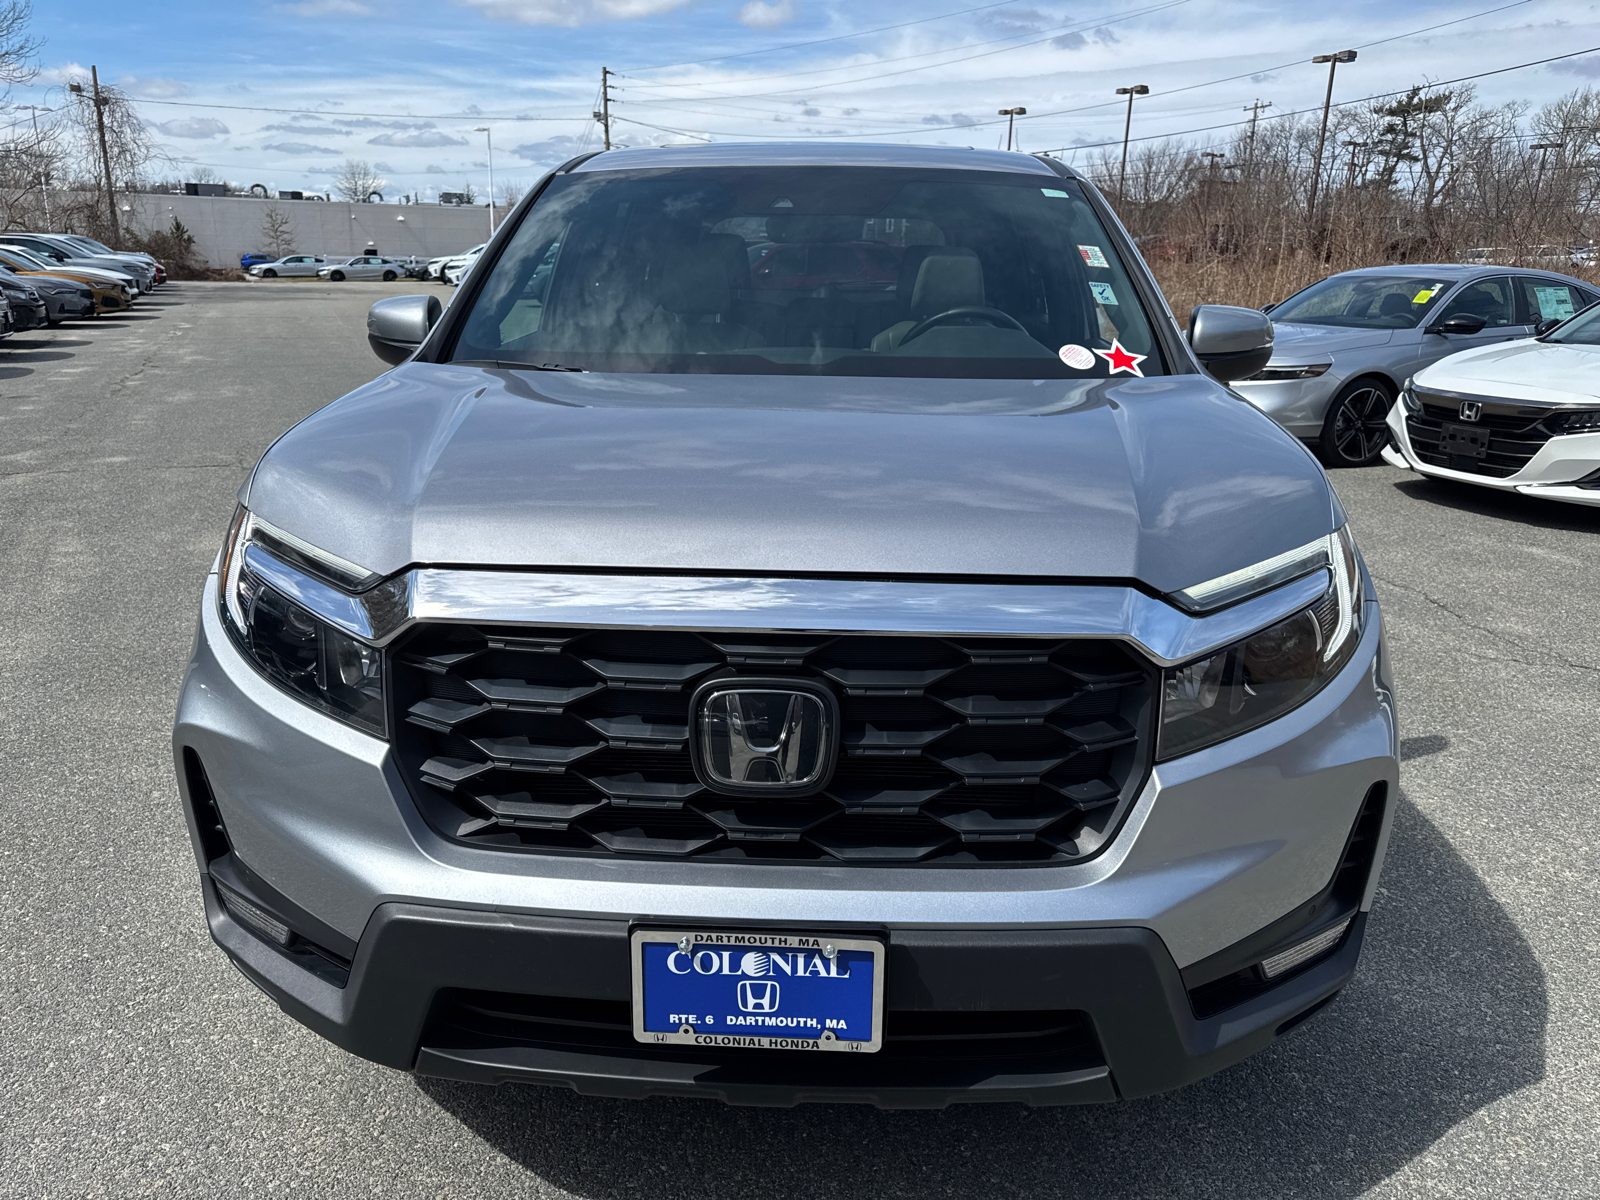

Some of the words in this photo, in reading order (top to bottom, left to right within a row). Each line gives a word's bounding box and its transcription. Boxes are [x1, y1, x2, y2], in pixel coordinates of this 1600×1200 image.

[694, 934, 793, 947] DARTMOUTH,
[798, 938, 821, 948] MA
[666, 950, 850, 978] COLONIAL
[669, 1014, 701, 1024] RTE.
[705, 1016, 714, 1025] 6
[726, 1016, 821, 1029] DARTMOUTH,
[825, 1019, 847, 1030] MA
[694, 1035, 765, 1048] COLONIAL
[768, 1039, 820, 1050] HONDA
